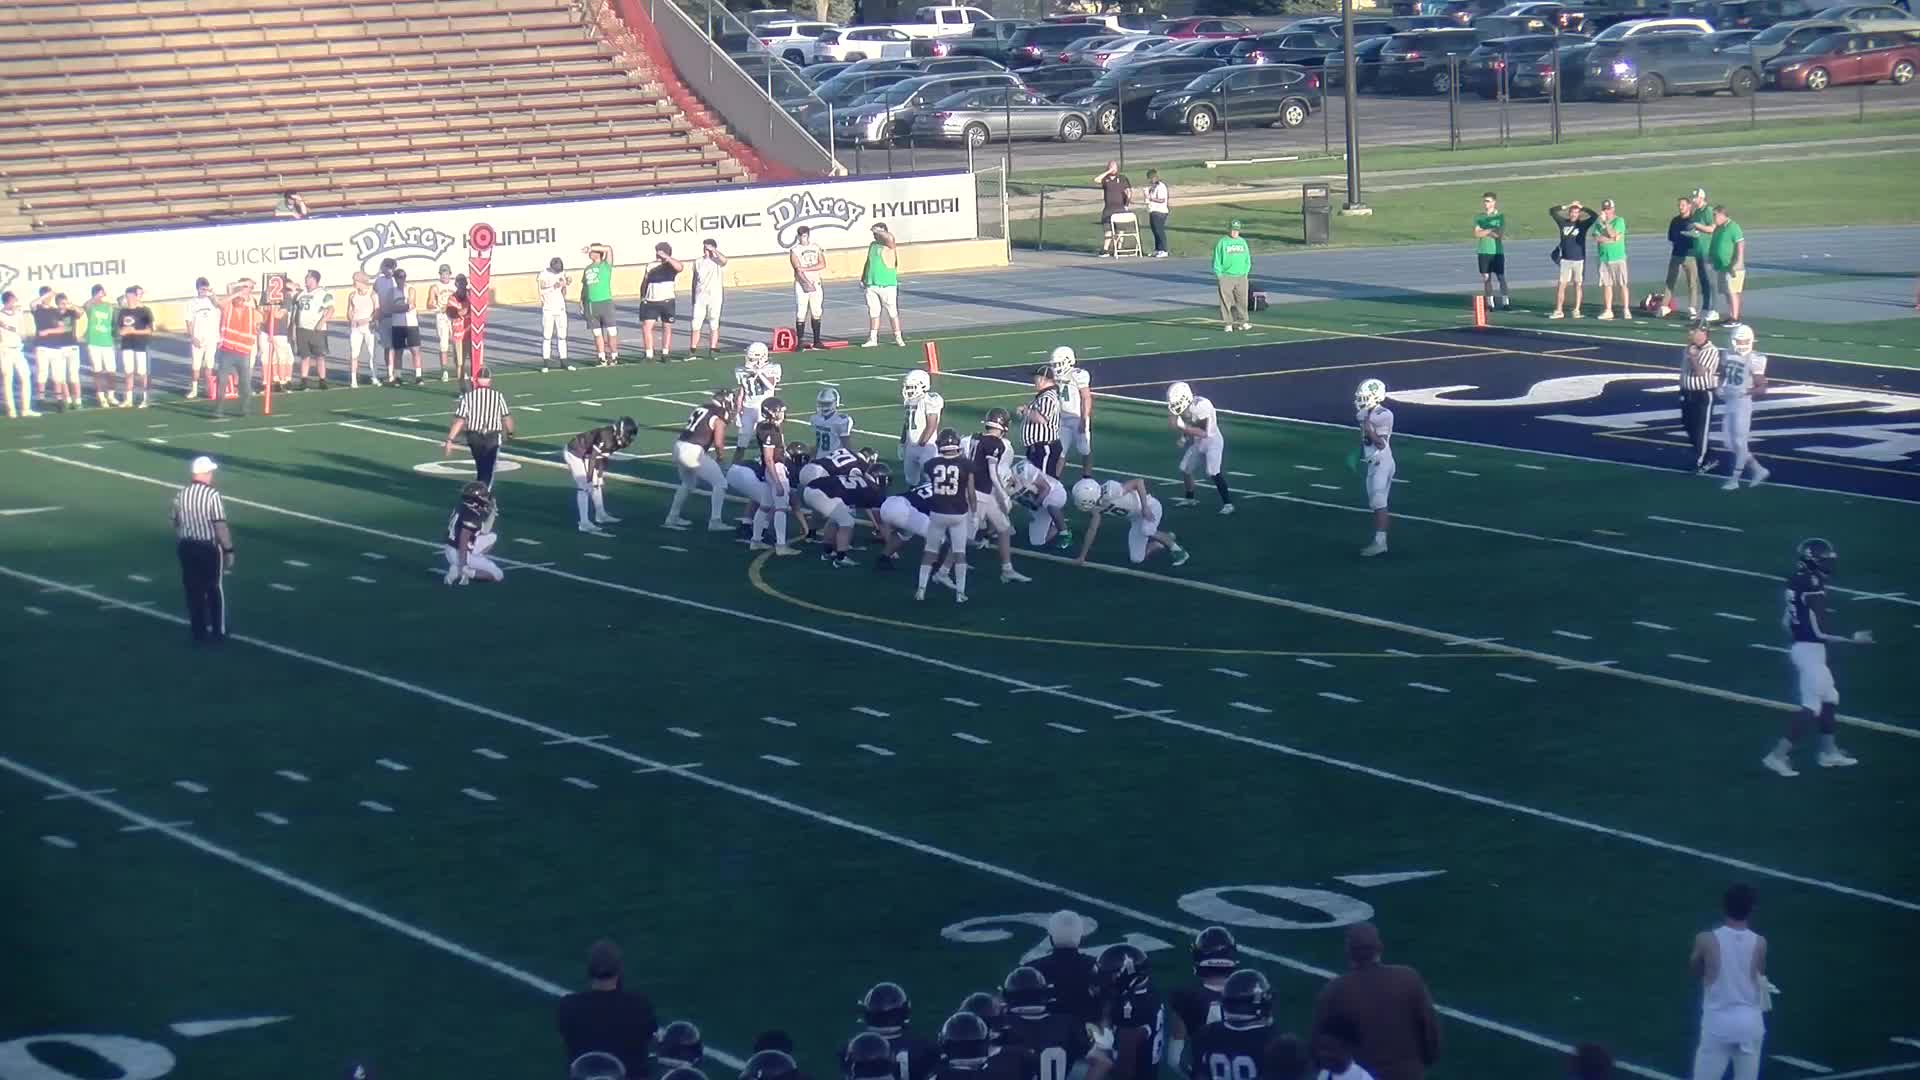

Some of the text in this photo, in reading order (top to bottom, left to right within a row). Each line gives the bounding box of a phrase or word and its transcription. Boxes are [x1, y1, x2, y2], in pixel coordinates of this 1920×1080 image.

[767, 190, 865, 231] D'Arcy
[872, 197, 960, 220] HYUNDAI
[641, 210, 762, 236] BUICK GMC
[350, 220, 456, 263] D'Arcy
[216, 242, 344, 268] BUICK GMC
[28, 259, 127, 281] HYUNDAI
[269, 276, 284, 300] 2
[776, 330, 791, 349] G
[932, 464, 960, 496] 23
